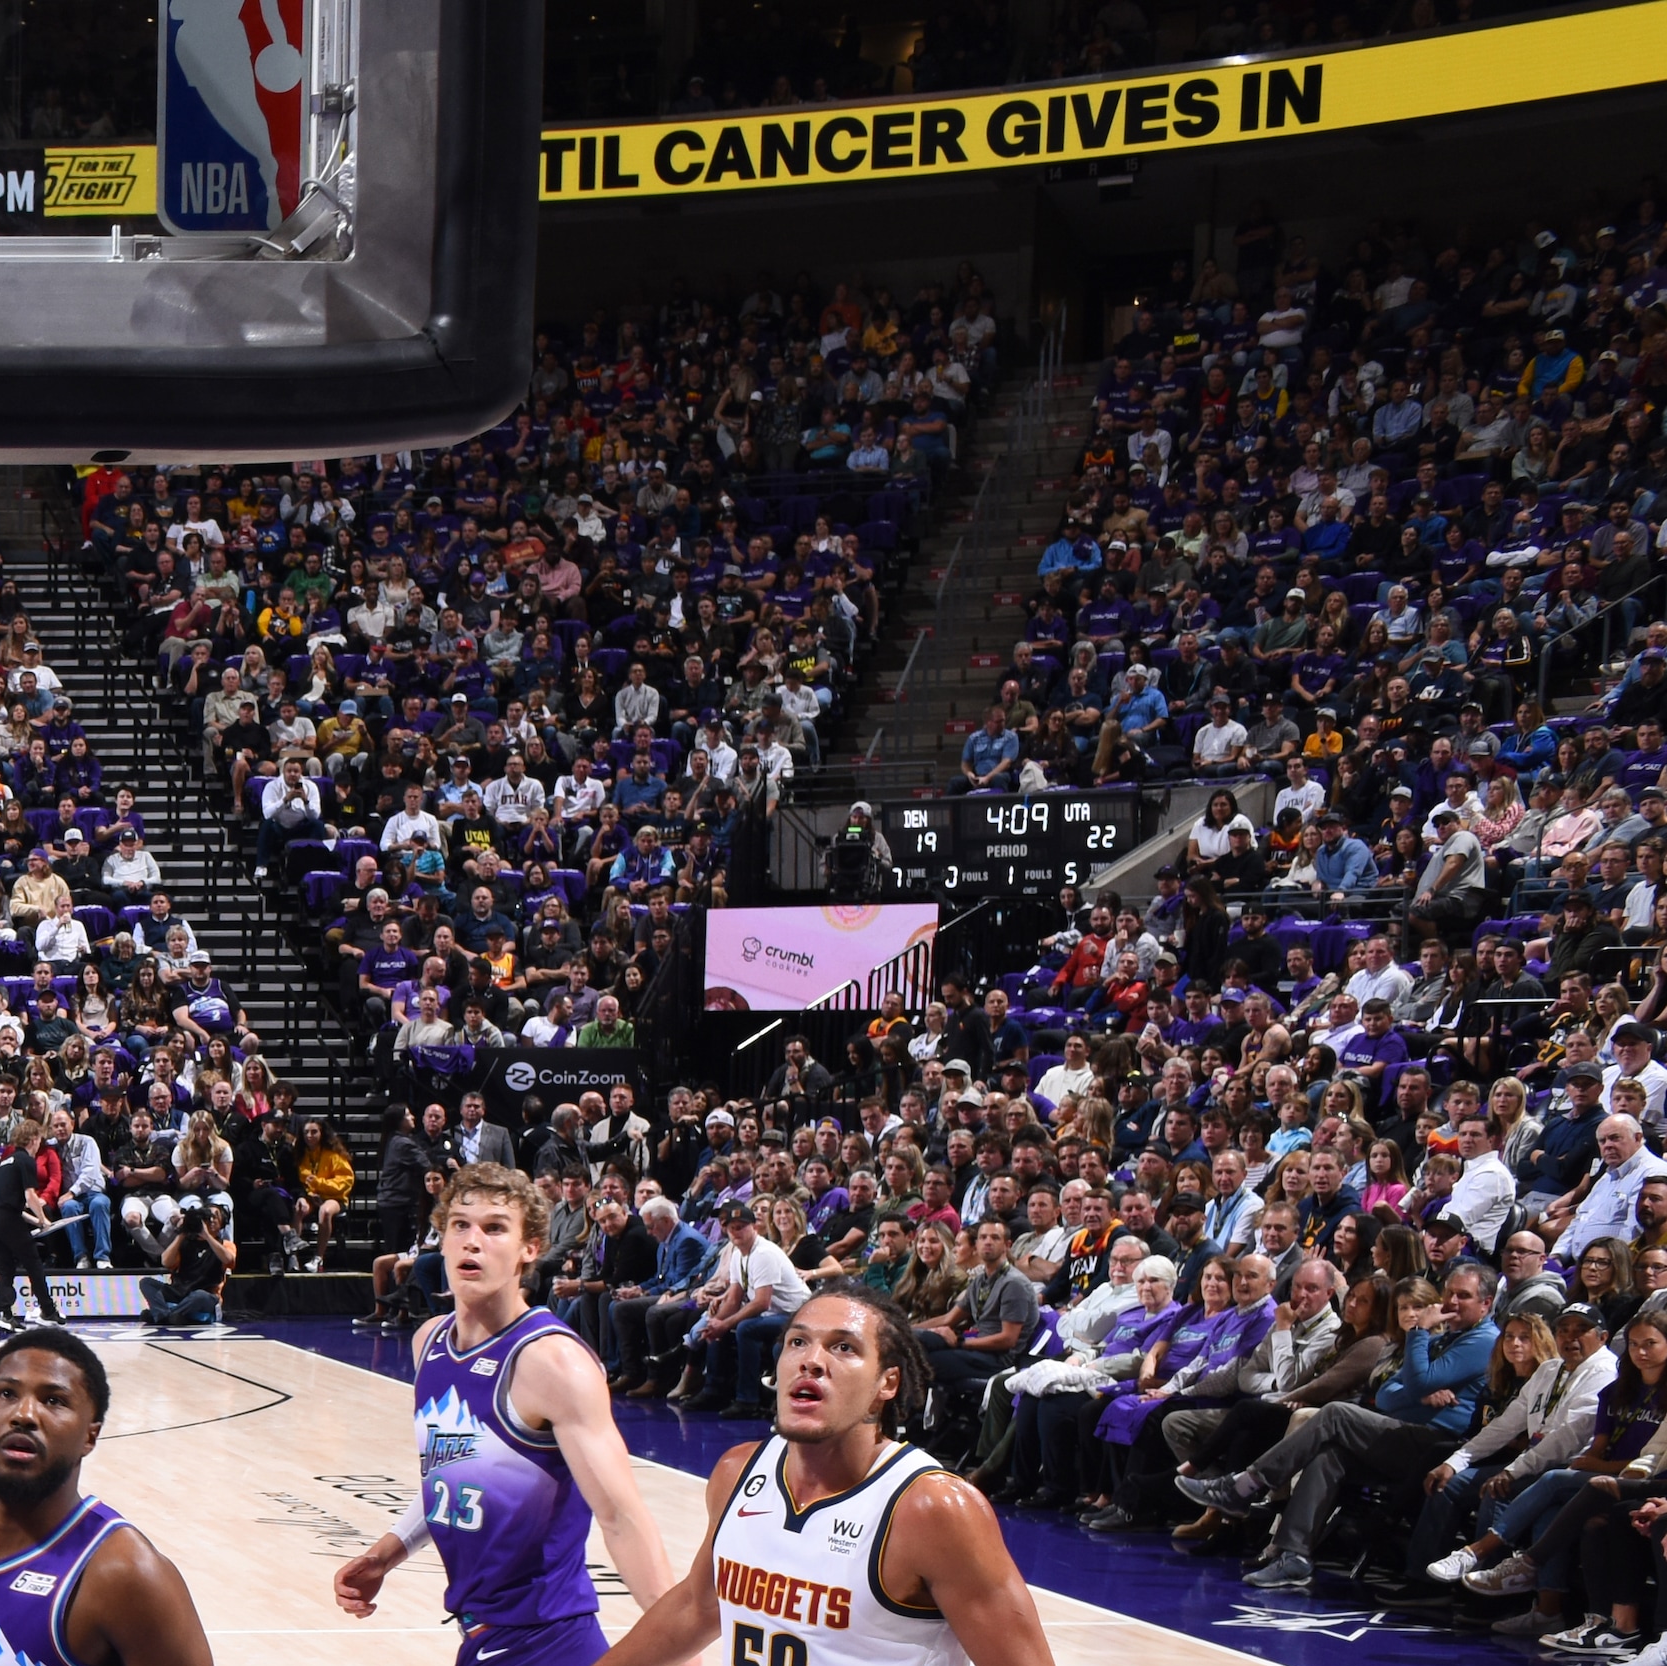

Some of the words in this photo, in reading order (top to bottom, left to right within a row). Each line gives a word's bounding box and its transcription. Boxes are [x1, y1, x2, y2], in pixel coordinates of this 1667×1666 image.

[540, 136, 641, 193] TIL
[654, 106, 969, 185] CANCER
[985, 78, 1220, 158] GIVES
[1236, 63, 1323, 130] IN
[76, 160, 99, 174] FOR
[100, 159, 124, 172] THE
[1048, 166, 1062, 181] 14
[1125, 157, 1138, 171] 15
[67, 180, 126, 200] FIGHT
[181, 161, 249, 215] NBA
[501, 794, 528, 806] UTAH
[903, 810, 927, 828] DEN
[987, 803, 1048, 835] 4:09
[1064, 803, 1090, 822] UTA
[464, 829, 492, 843] UTAH
[917, 832, 937, 852] 19
[1087, 825, 1116, 848] 22
[986, 844, 1028, 858] PERIOD
[892, 867, 903, 888] 7
[907, 868, 927, 878] TIME
[961, 871, 989, 882] FOULS
[1008, 865, 1015, 885] 1
[1024, 869, 1053, 880] FOULS
[1064, 861, 1077, 884] 5
[765, 946, 814, 969] crumbl
[765, 959, 809, 977] cookies
[1537, 1040, 1566, 1063] 27
[538, 1068, 626, 1087] CoinZoom
[1069, 1255, 1098, 1280] UTAH
[19, 1281, 85, 1297] cmbl
[419, 1423, 484, 1480] JAZZ
[745, 1475, 766, 1498] 6
[426, 1476, 485, 1533] 23
[833, 1518, 864, 1539] WU
[827, 1535, 857, 1549] Western
[829, 1544, 850, 1556] Union
[14, 1573, 28, 1588] 5
[717, 1556, 853, 1631] NUGGETS
